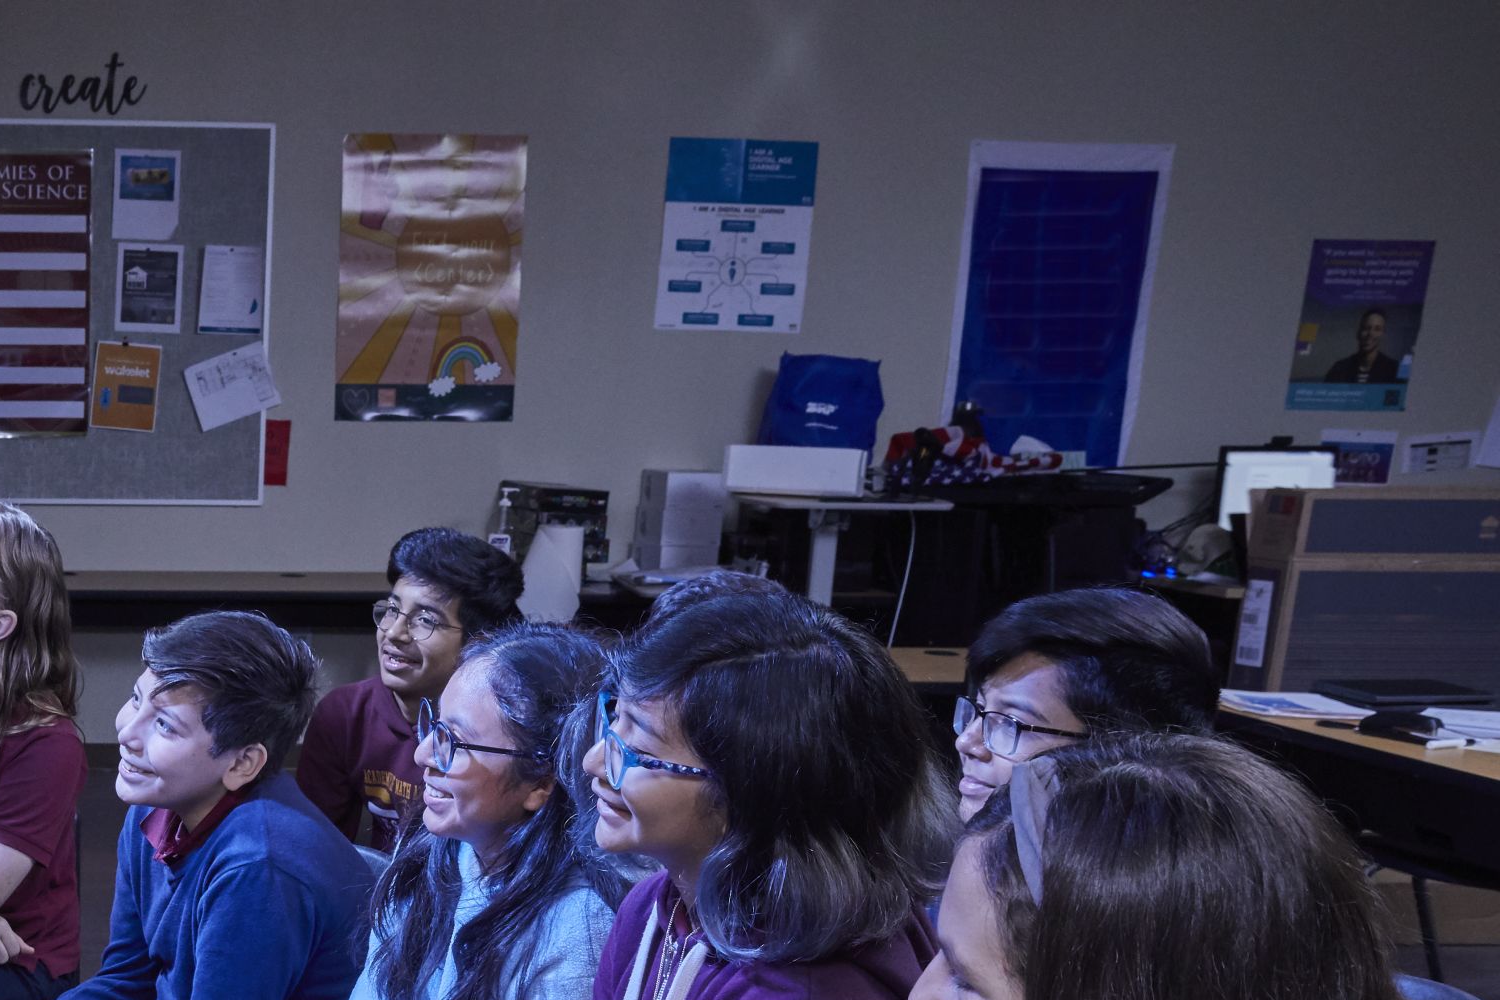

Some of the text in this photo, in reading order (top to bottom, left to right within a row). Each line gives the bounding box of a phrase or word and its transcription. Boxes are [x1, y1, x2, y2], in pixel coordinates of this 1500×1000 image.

[19, 51, 148, 116] create
[47, 164, 75, 182] OF
[1, 181, 88, 201] SCIENCE
